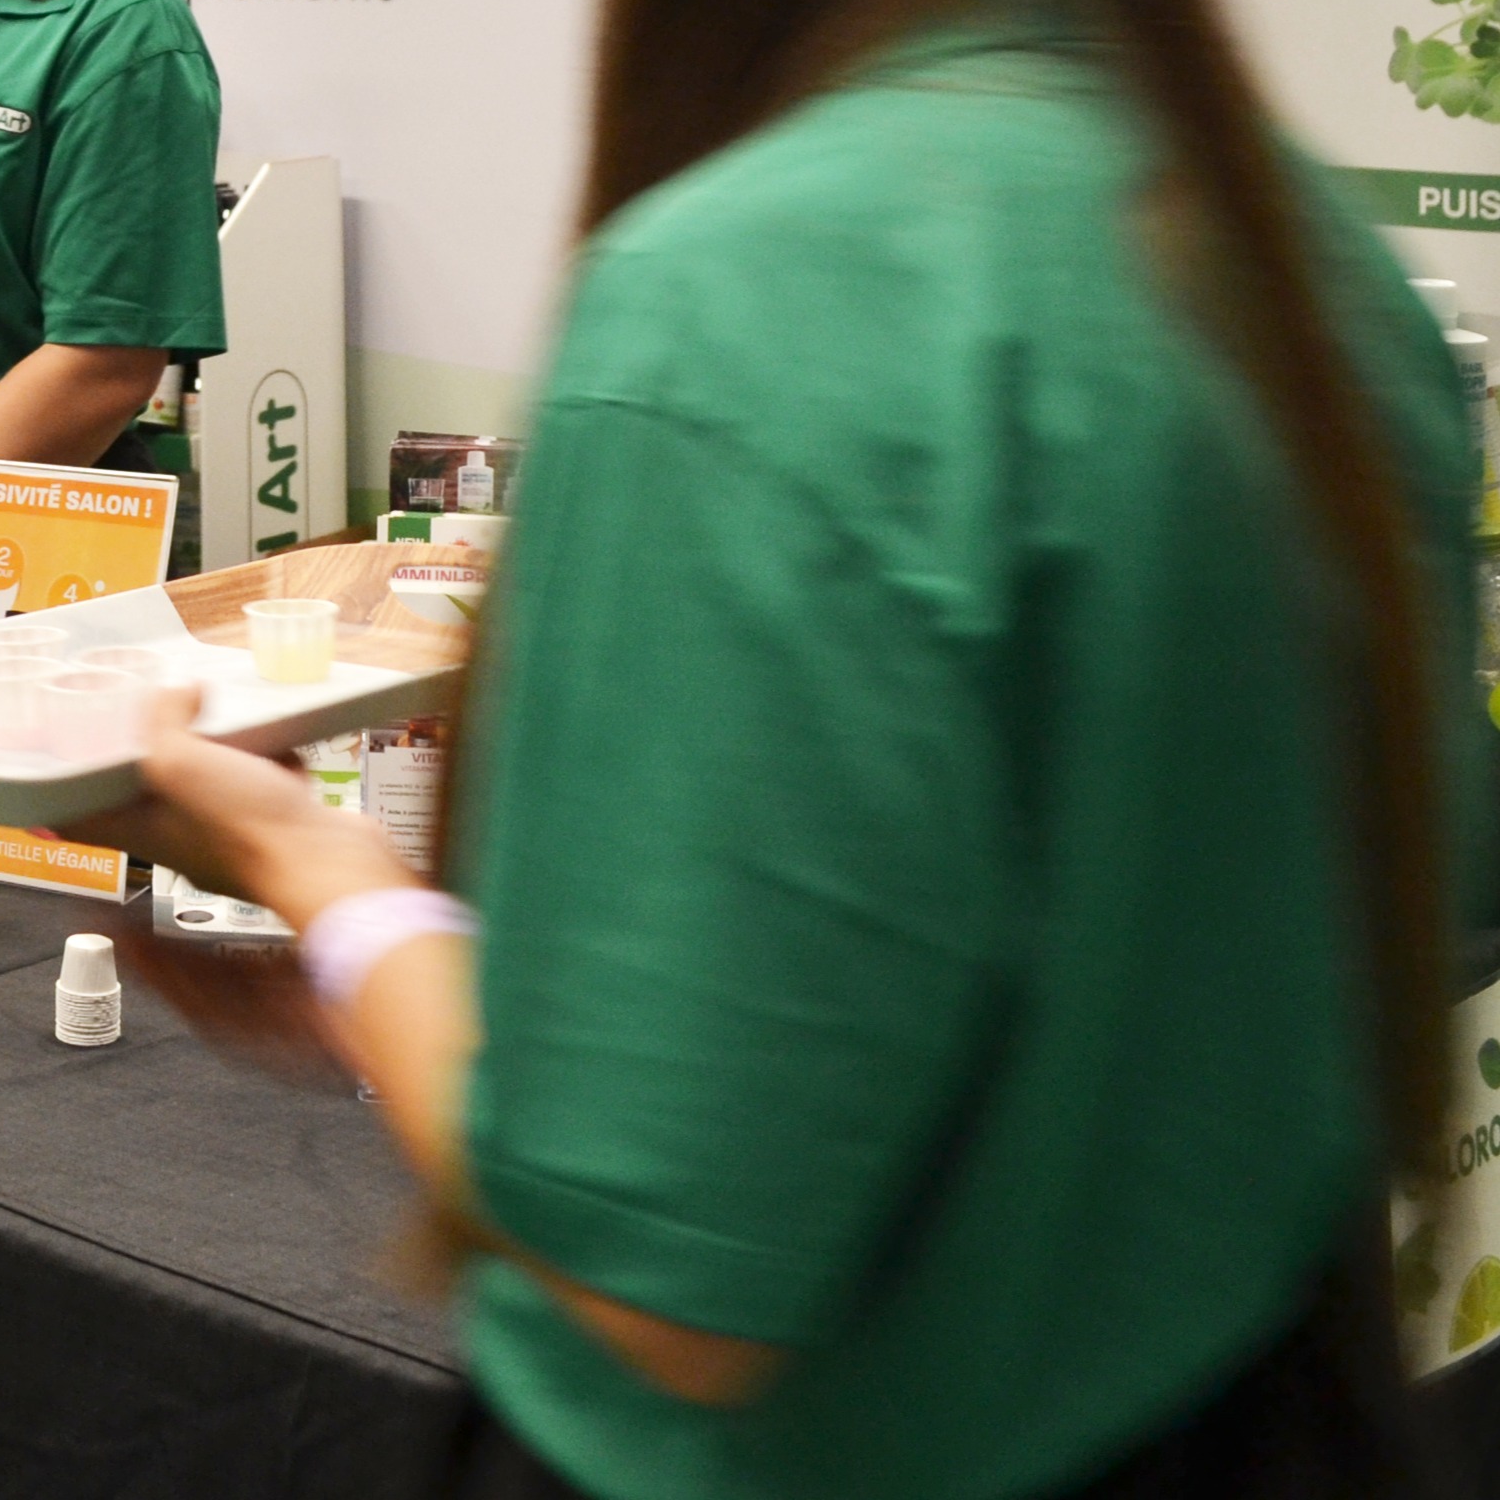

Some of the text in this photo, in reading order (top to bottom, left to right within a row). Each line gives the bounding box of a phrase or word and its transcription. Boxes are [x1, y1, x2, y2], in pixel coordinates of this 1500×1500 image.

[257, 398, 299, 514] Art
[65, 490, 140, 518] SALON
[143, 498, 153, 518] !
[62, 582, 78, 603] 4
[46, 846, 115, 875] VÉGANE
